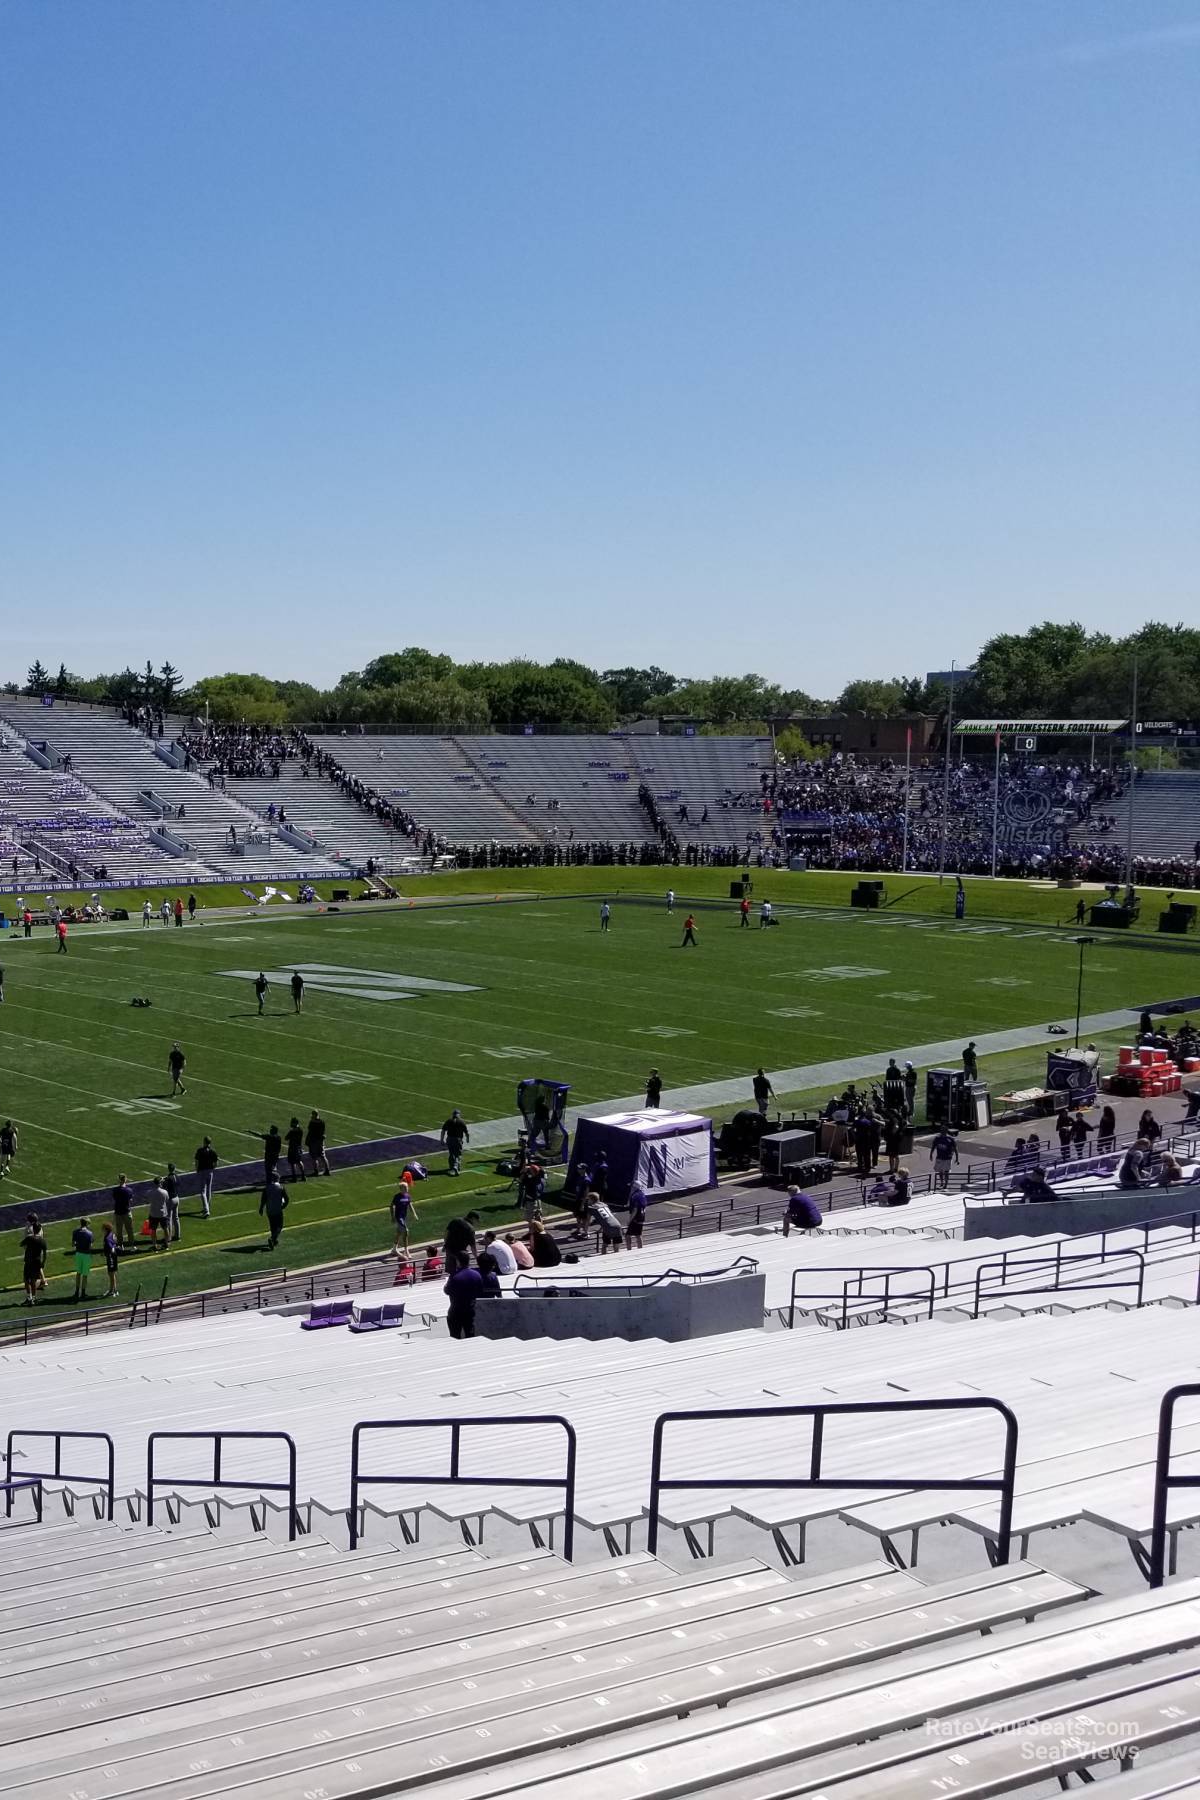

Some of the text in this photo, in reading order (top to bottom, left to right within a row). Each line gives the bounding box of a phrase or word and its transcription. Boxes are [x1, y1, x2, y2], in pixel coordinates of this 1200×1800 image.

[996, 723, 1065, 732] NORTHWESTERN
[1066, 723, 1110, 732] FOOTBALL
[1136, 722, 1143, 733] 0
[1025, 738, 1033, 749] 0
[995, 825, 1064, 842] Allstate
[482, 1046, 551, 1059] 40
[301, 1069, 380, 1085] 30
[96, 1097, 182, 1116] 20
[647, 1144, 668, 1189] N
